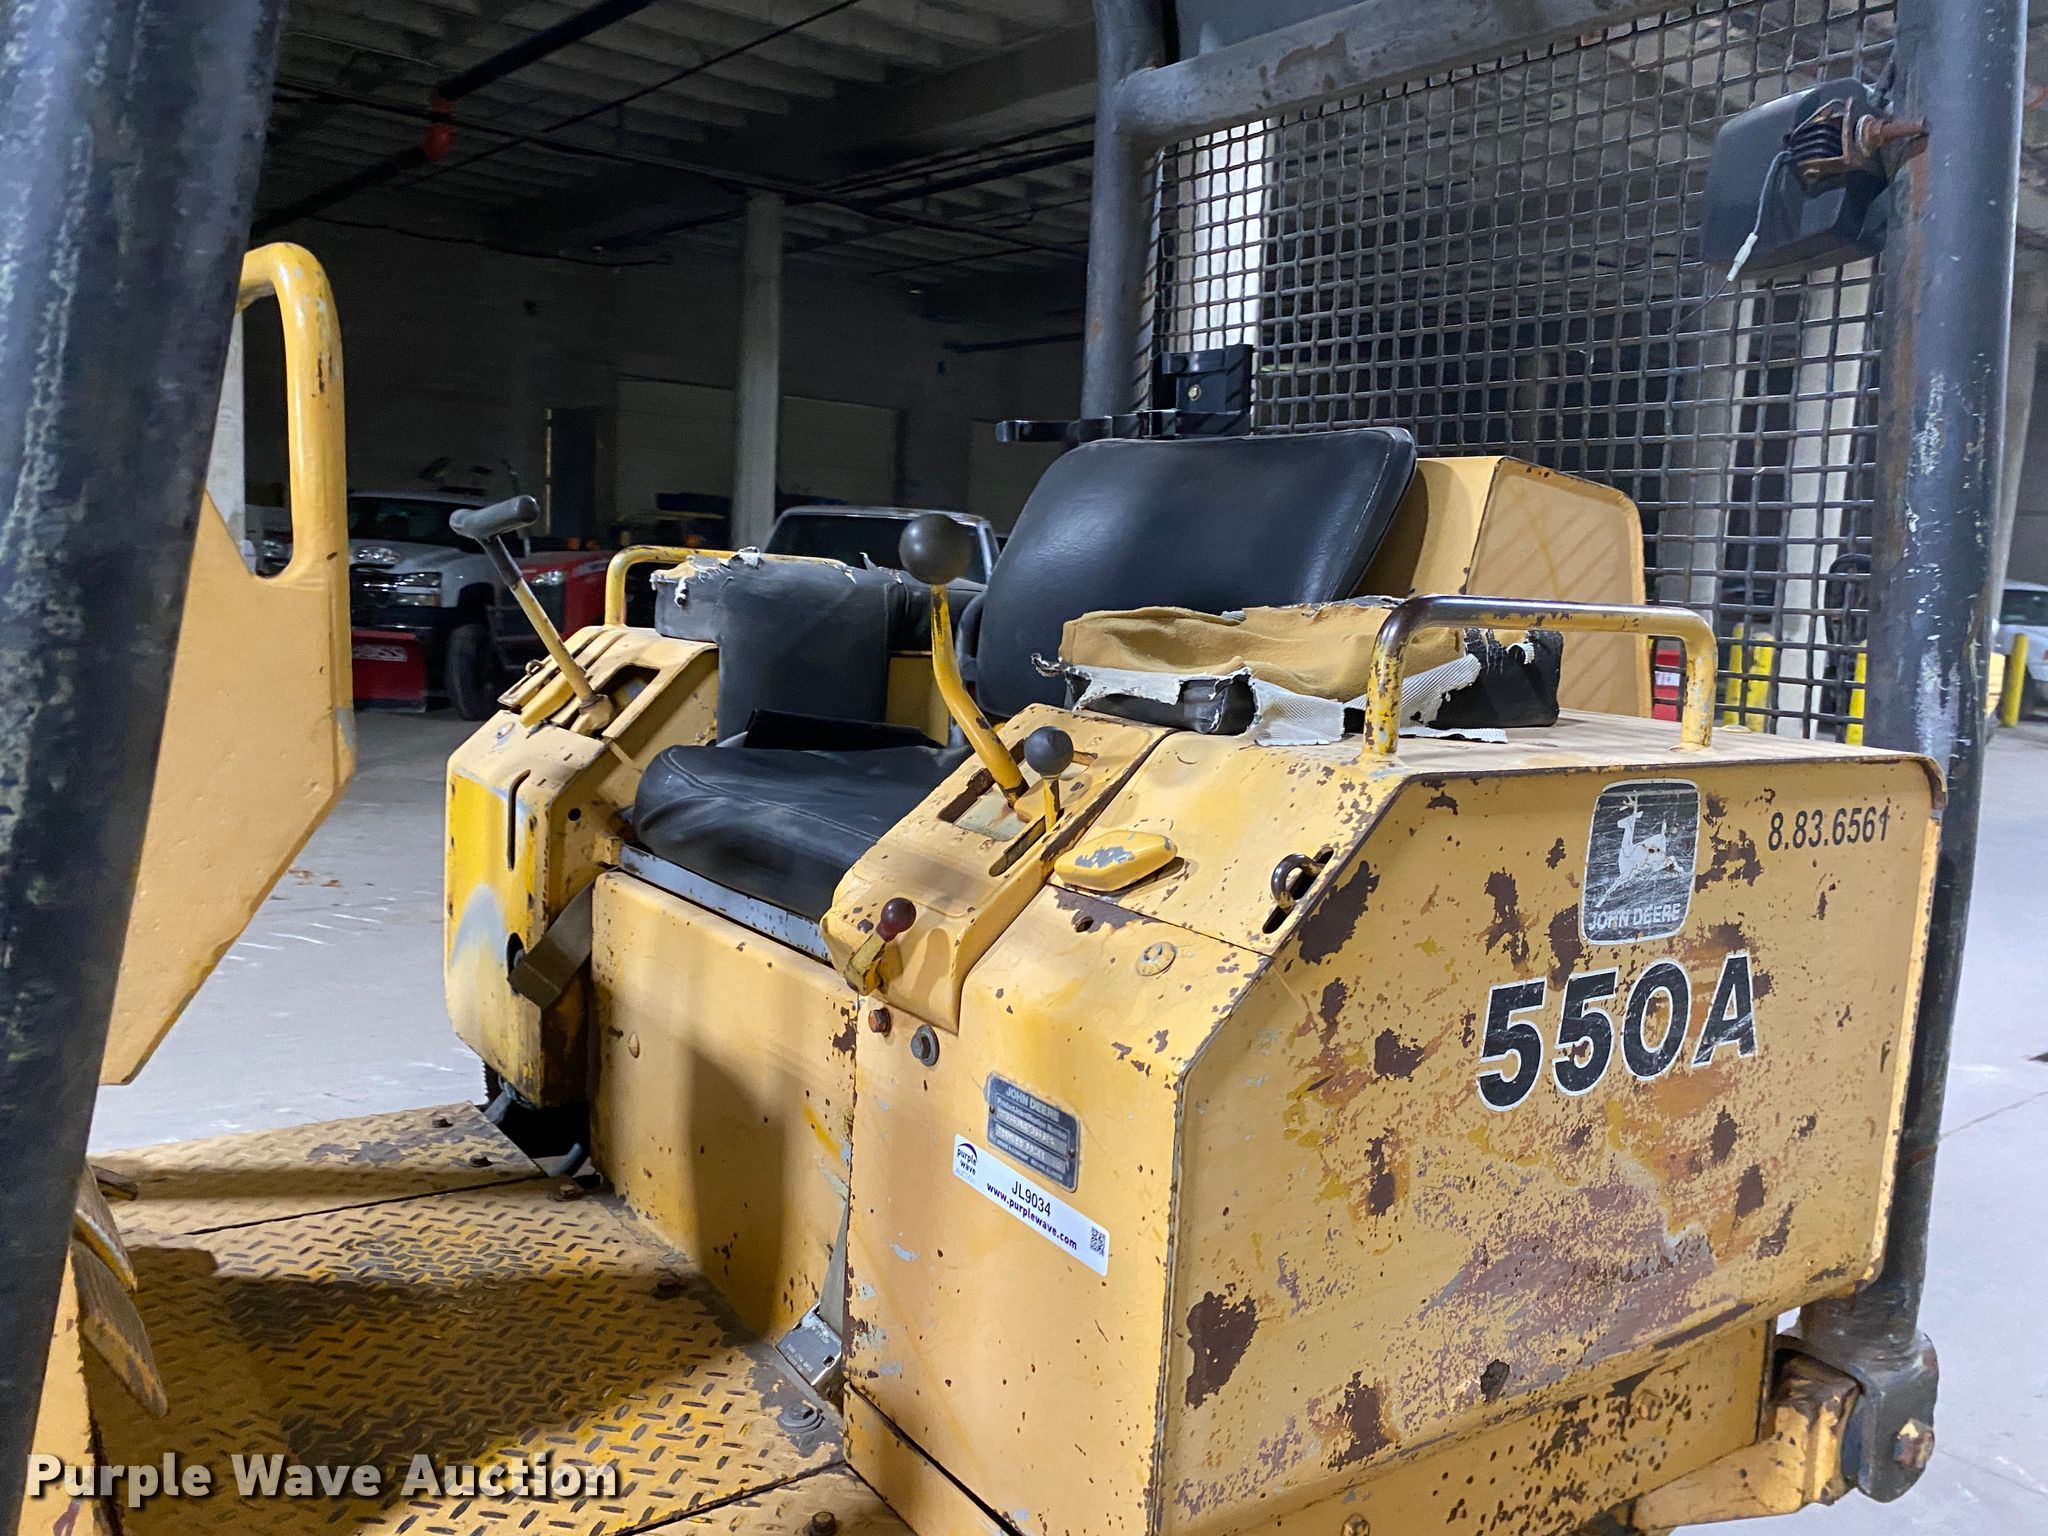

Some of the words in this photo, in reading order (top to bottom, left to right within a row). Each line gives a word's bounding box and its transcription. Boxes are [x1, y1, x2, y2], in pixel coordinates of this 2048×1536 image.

[1768, 805, 1889, 851] 8.83.6561
[1588, 908, 1630, 930] JOHN
[1633, 902, 1681, 926] DEERE
[1477, 950, 1757, 1113] 550A
[1005, 1086, 1029, 1106] JOHN
[986, 1182, 1077, 1251] www.purplewave.com
[1011, 1181, 1051, 1217] JL9034
